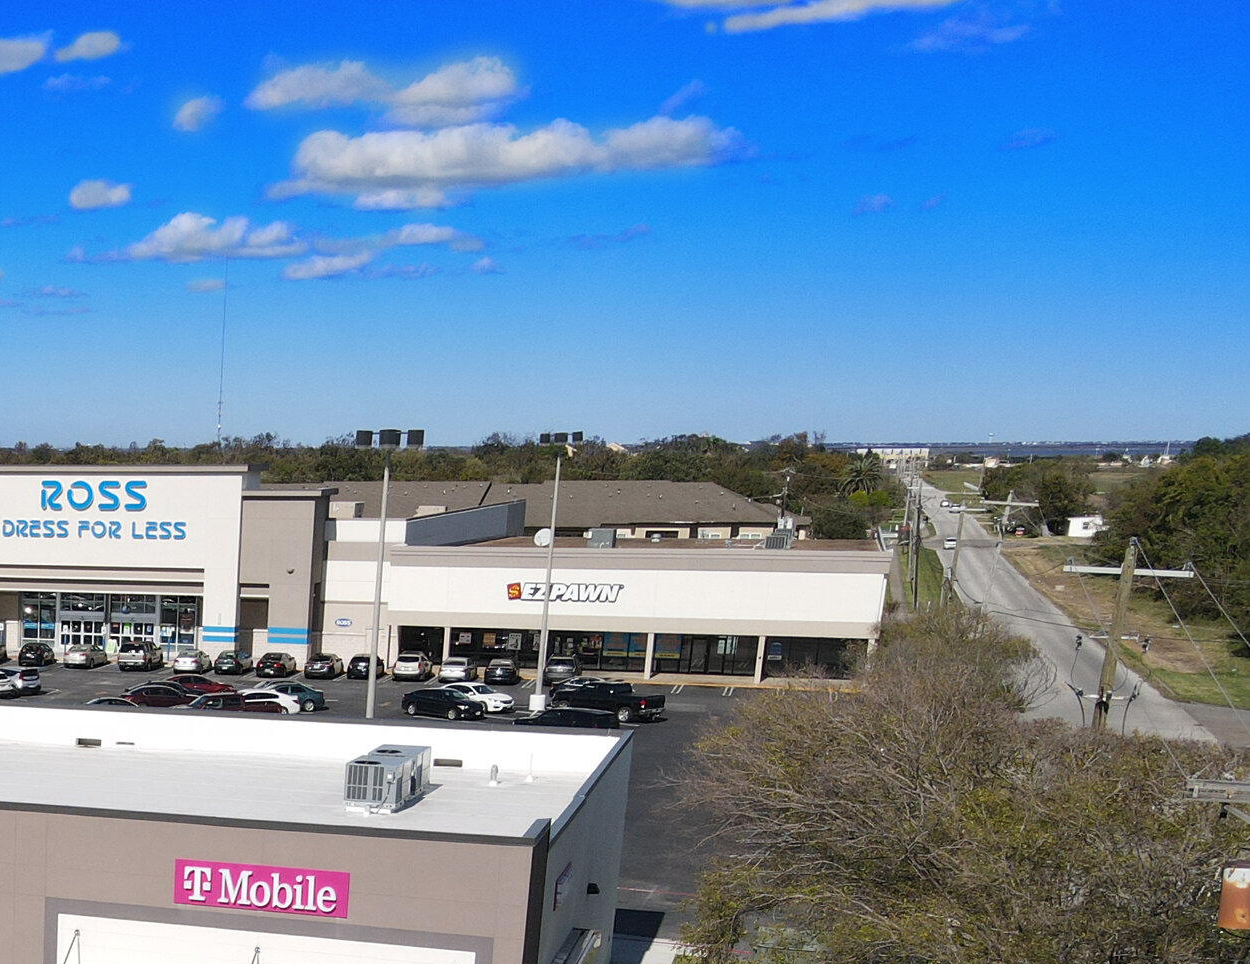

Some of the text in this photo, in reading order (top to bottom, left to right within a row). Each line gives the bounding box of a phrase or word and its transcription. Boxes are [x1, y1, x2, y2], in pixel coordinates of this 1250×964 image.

[40, 480, 148, 511] ROSS
[2, 519, 186, 540] DRESS FOR LESS
